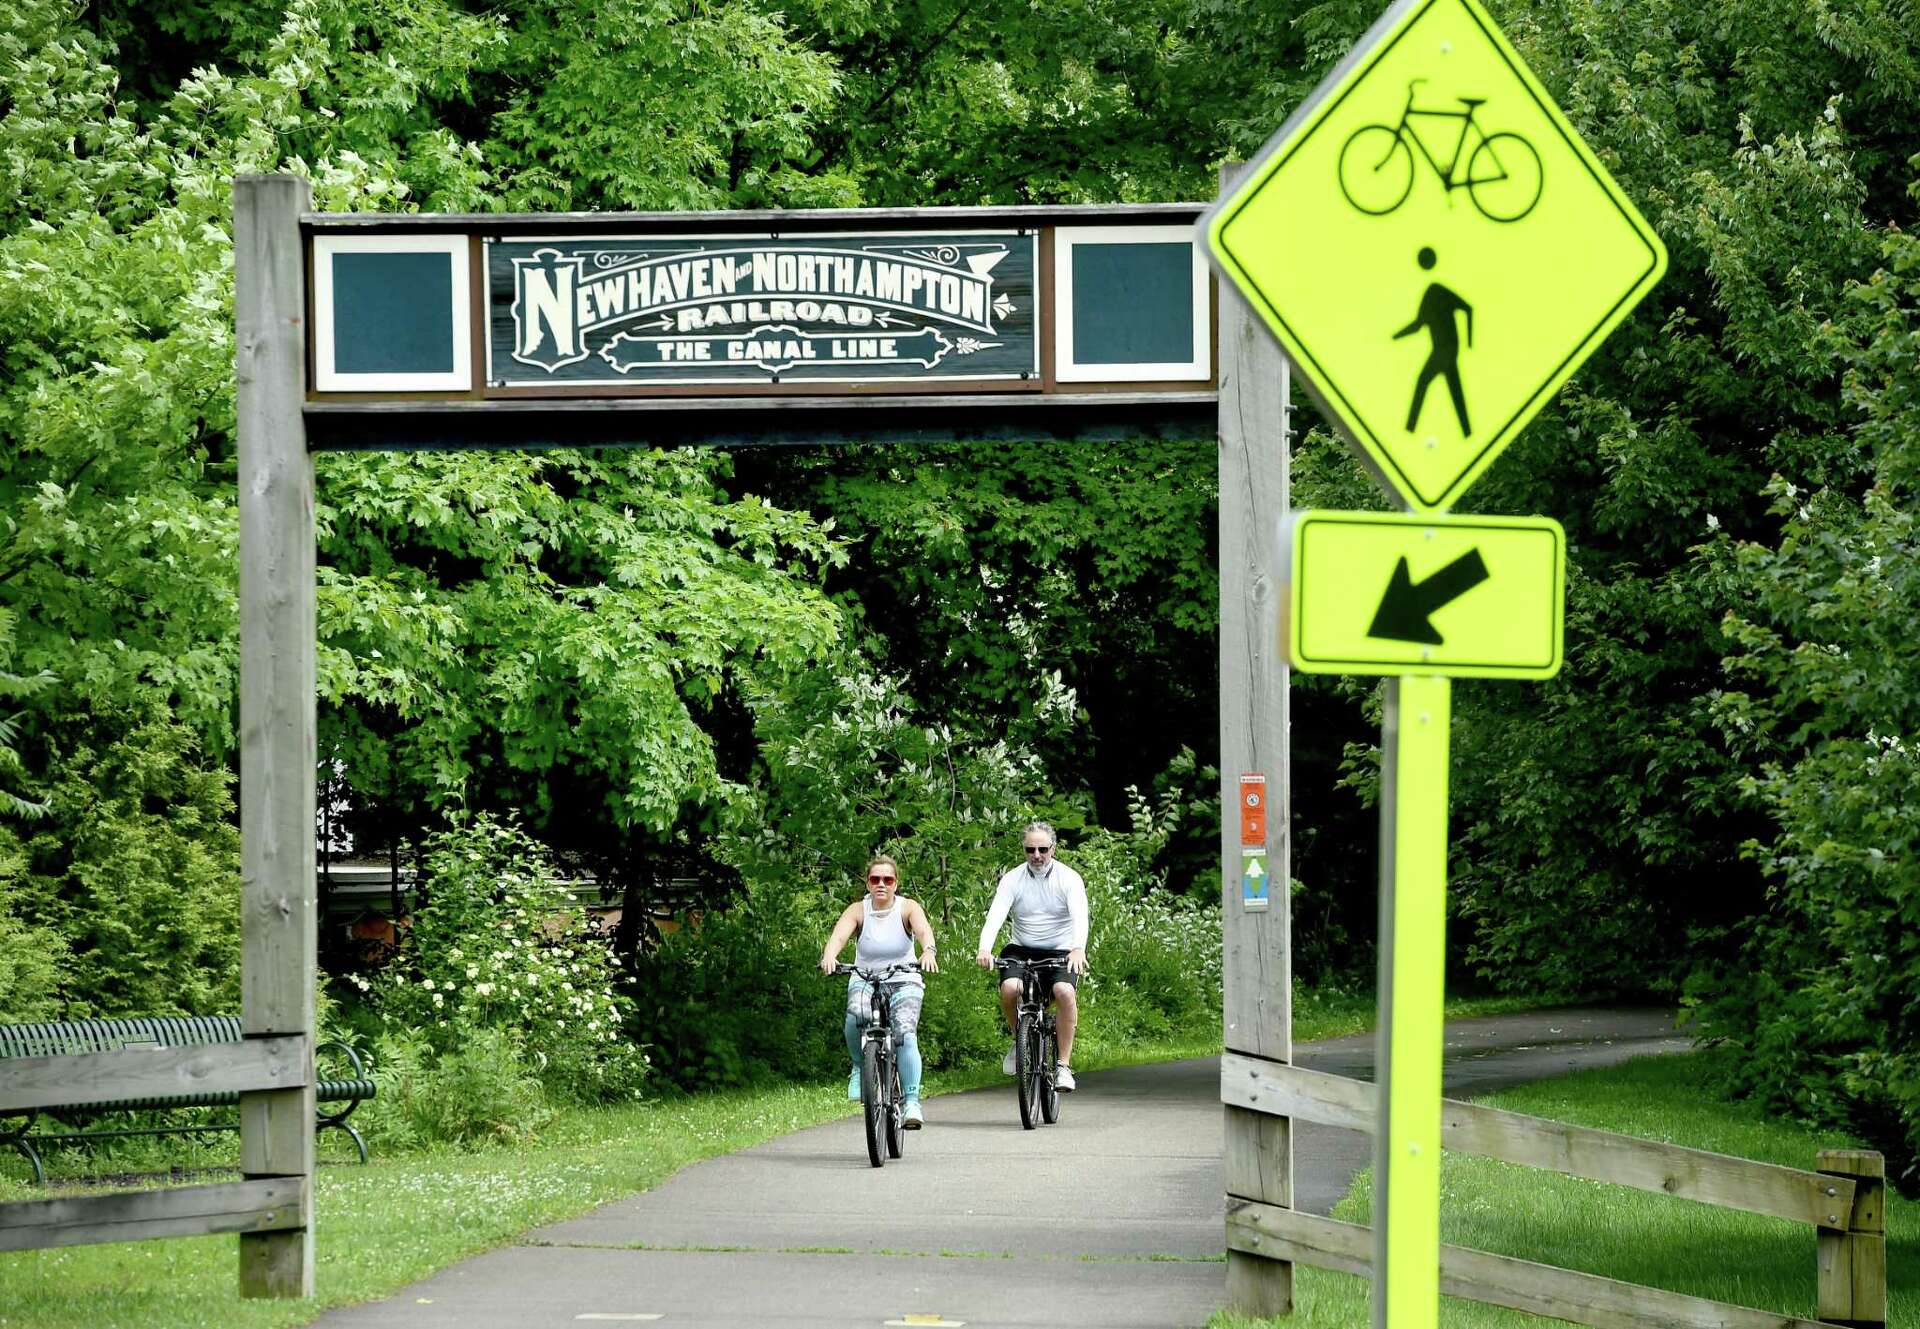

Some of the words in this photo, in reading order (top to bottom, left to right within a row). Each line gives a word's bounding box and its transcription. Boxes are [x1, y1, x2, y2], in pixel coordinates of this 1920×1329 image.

[753, 253, 984, 323] NORTHAMPTON
[677, 301, 873, 332] RAILROAD
[657, 341, 711, 361] THE
[727, 340, 816, 360] CANAL
[832, 339, 898, 358] LINE
